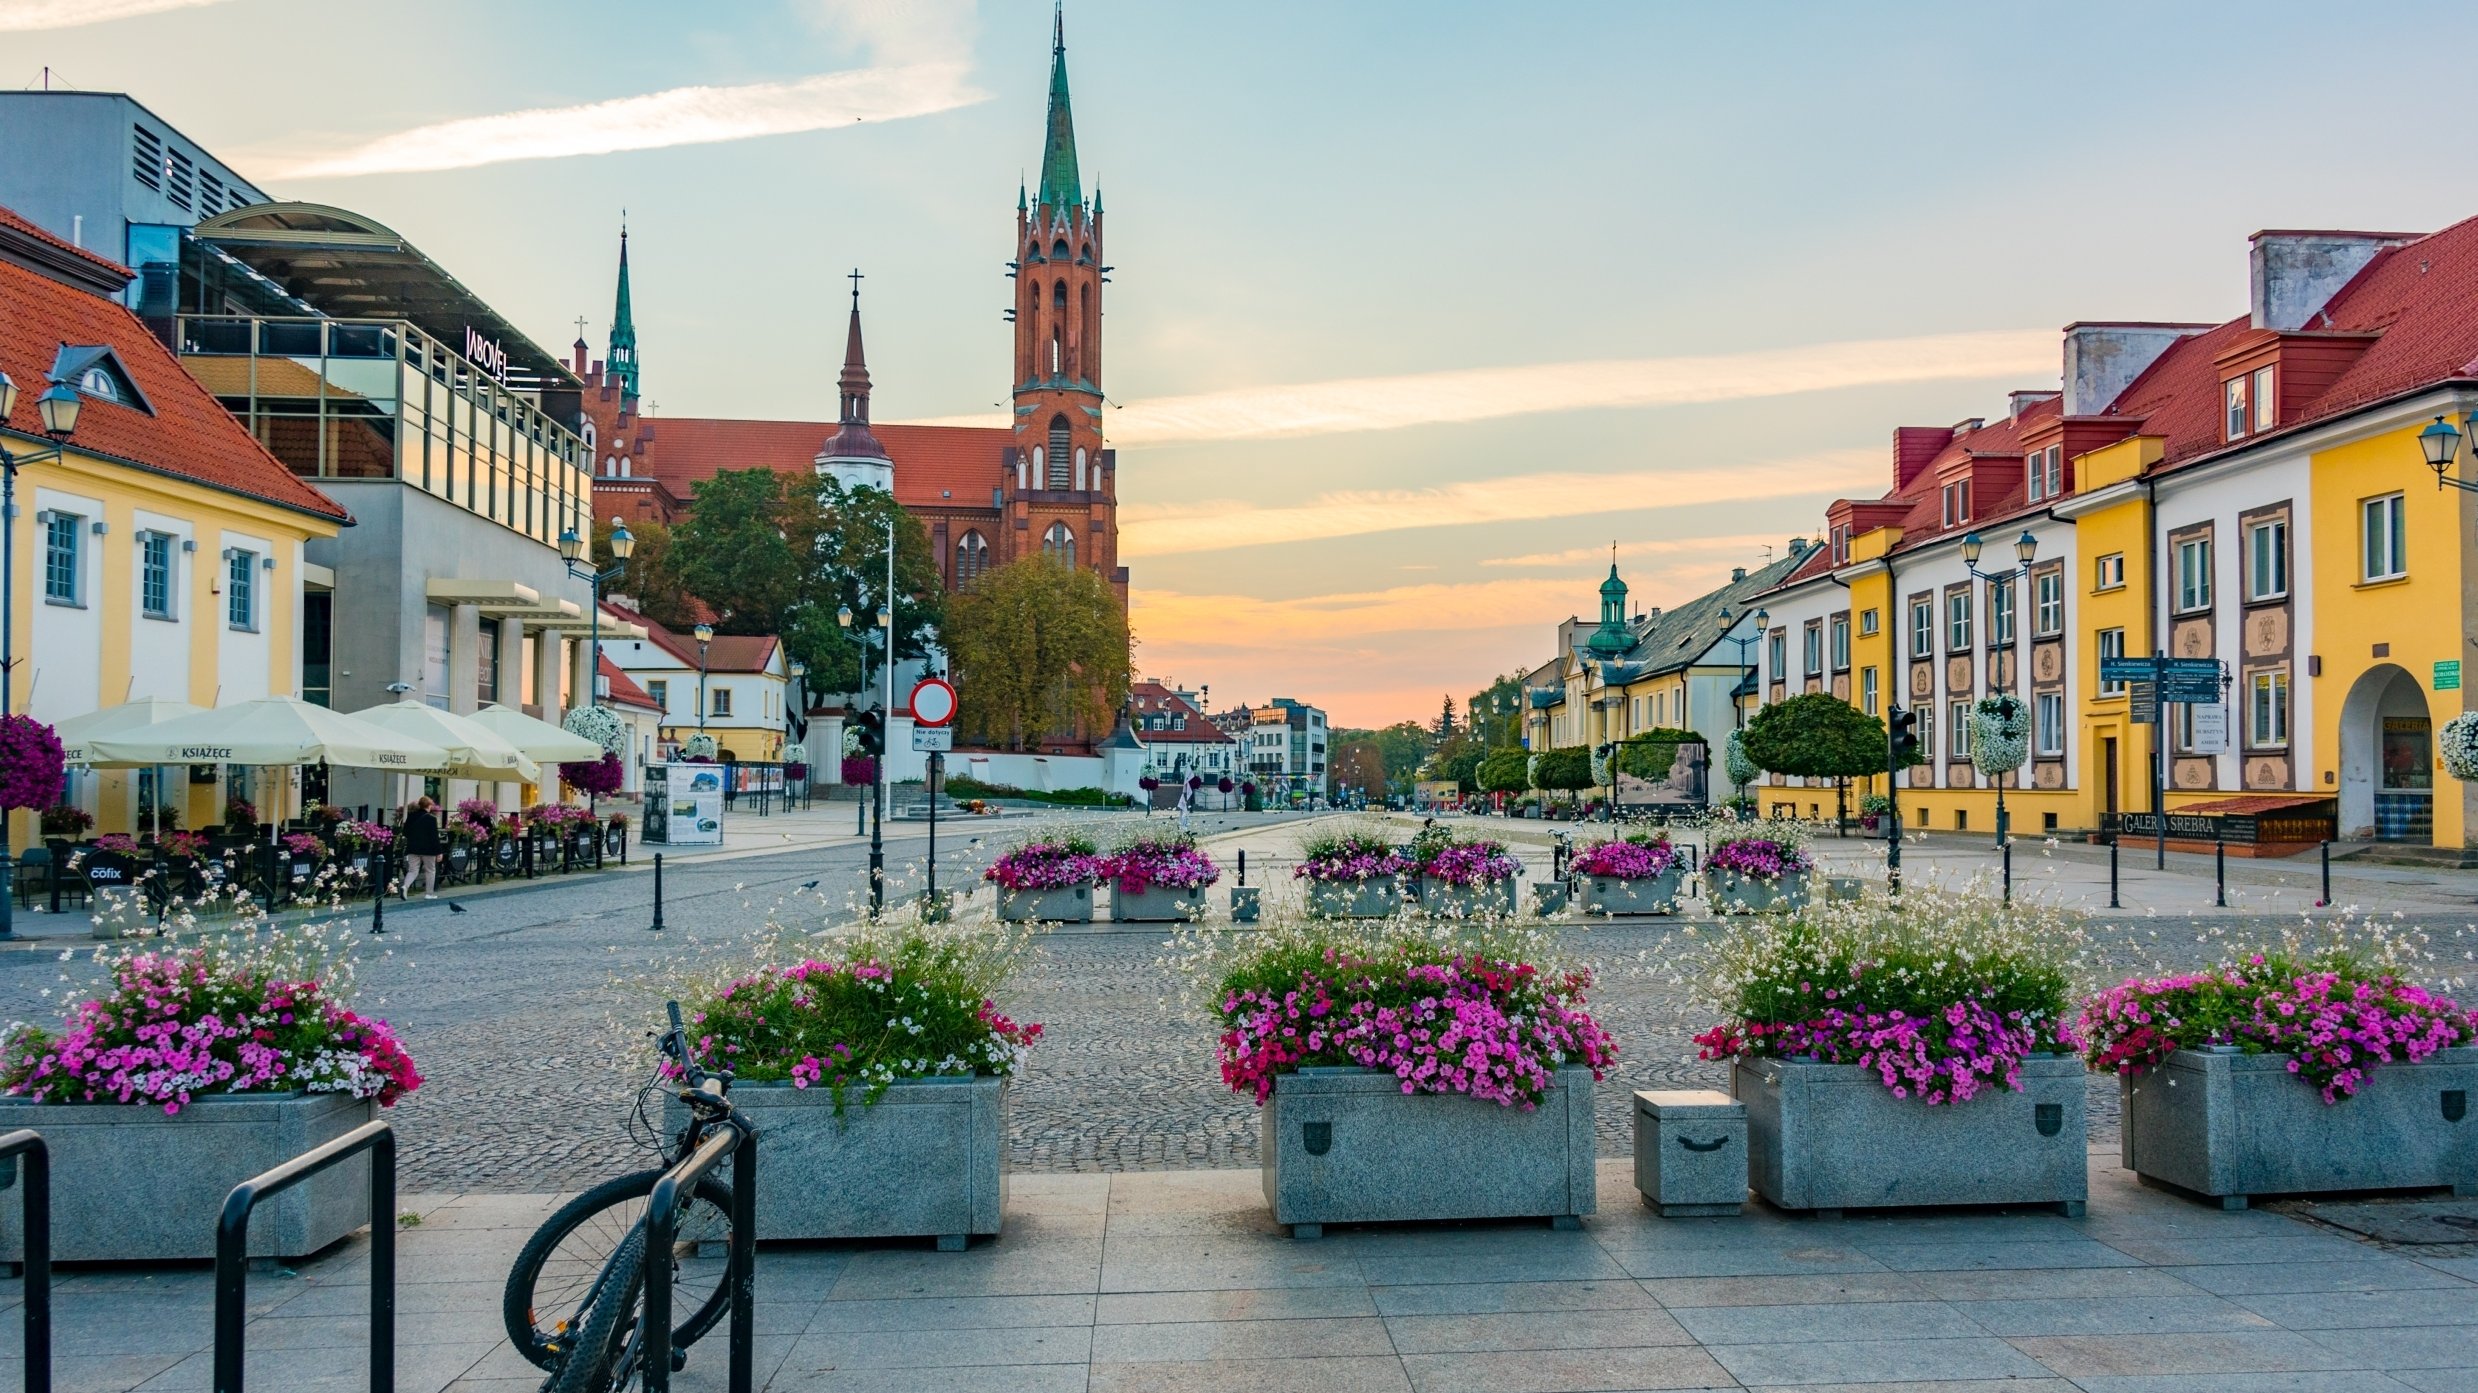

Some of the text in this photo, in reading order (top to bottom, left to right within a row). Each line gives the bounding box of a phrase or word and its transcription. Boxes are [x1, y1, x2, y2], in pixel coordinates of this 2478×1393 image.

[2384, 721, 2430, 731] GALERIA
[182, 745, 232, 760] KSIĄŻĘCE
[379, 752, 407, 766] KSIĄŻĘCE
[2124, 814, 2168, 833] GALERA
[2170, 816, 2214, 833] SREBRA
[90, 867, 122, 879] cofix
